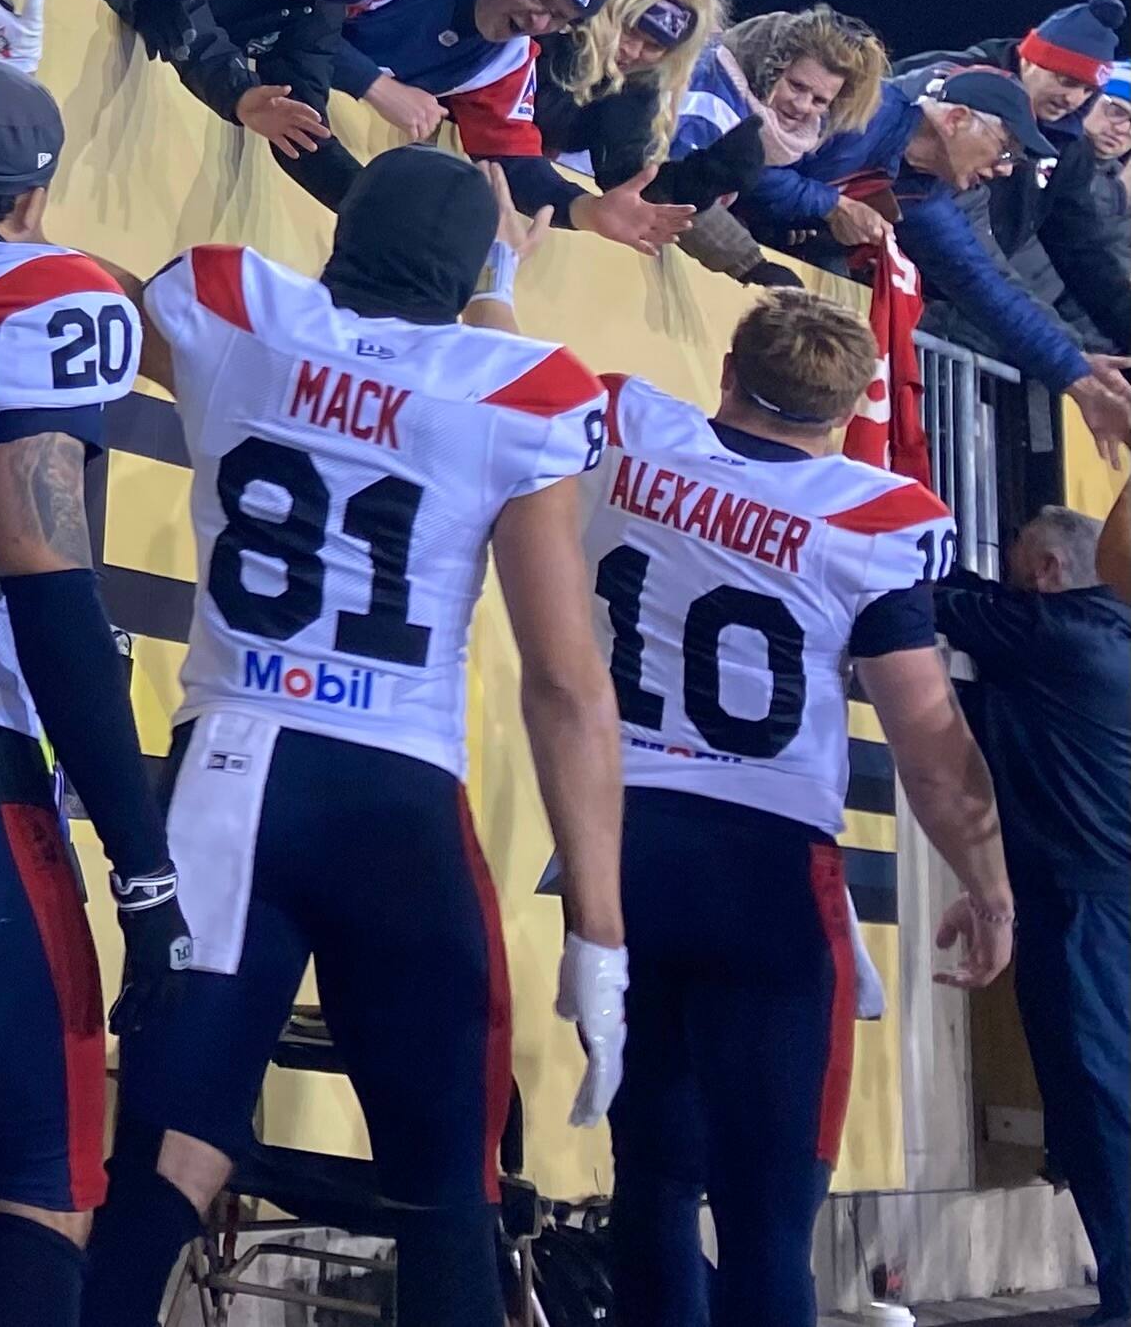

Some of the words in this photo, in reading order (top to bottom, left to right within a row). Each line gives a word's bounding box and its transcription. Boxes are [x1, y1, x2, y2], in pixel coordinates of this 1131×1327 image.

[46, 304, 132, 389] 20
[289, 359, 413, 451] MACK
[208, 436, 432, 667] 81
[609, 456, 811, 573] ALEXANDER
[916, 529, 958, 586] 10
[244, 650, 374, 709] Mobil
[595, 544, 806, 759] 10
